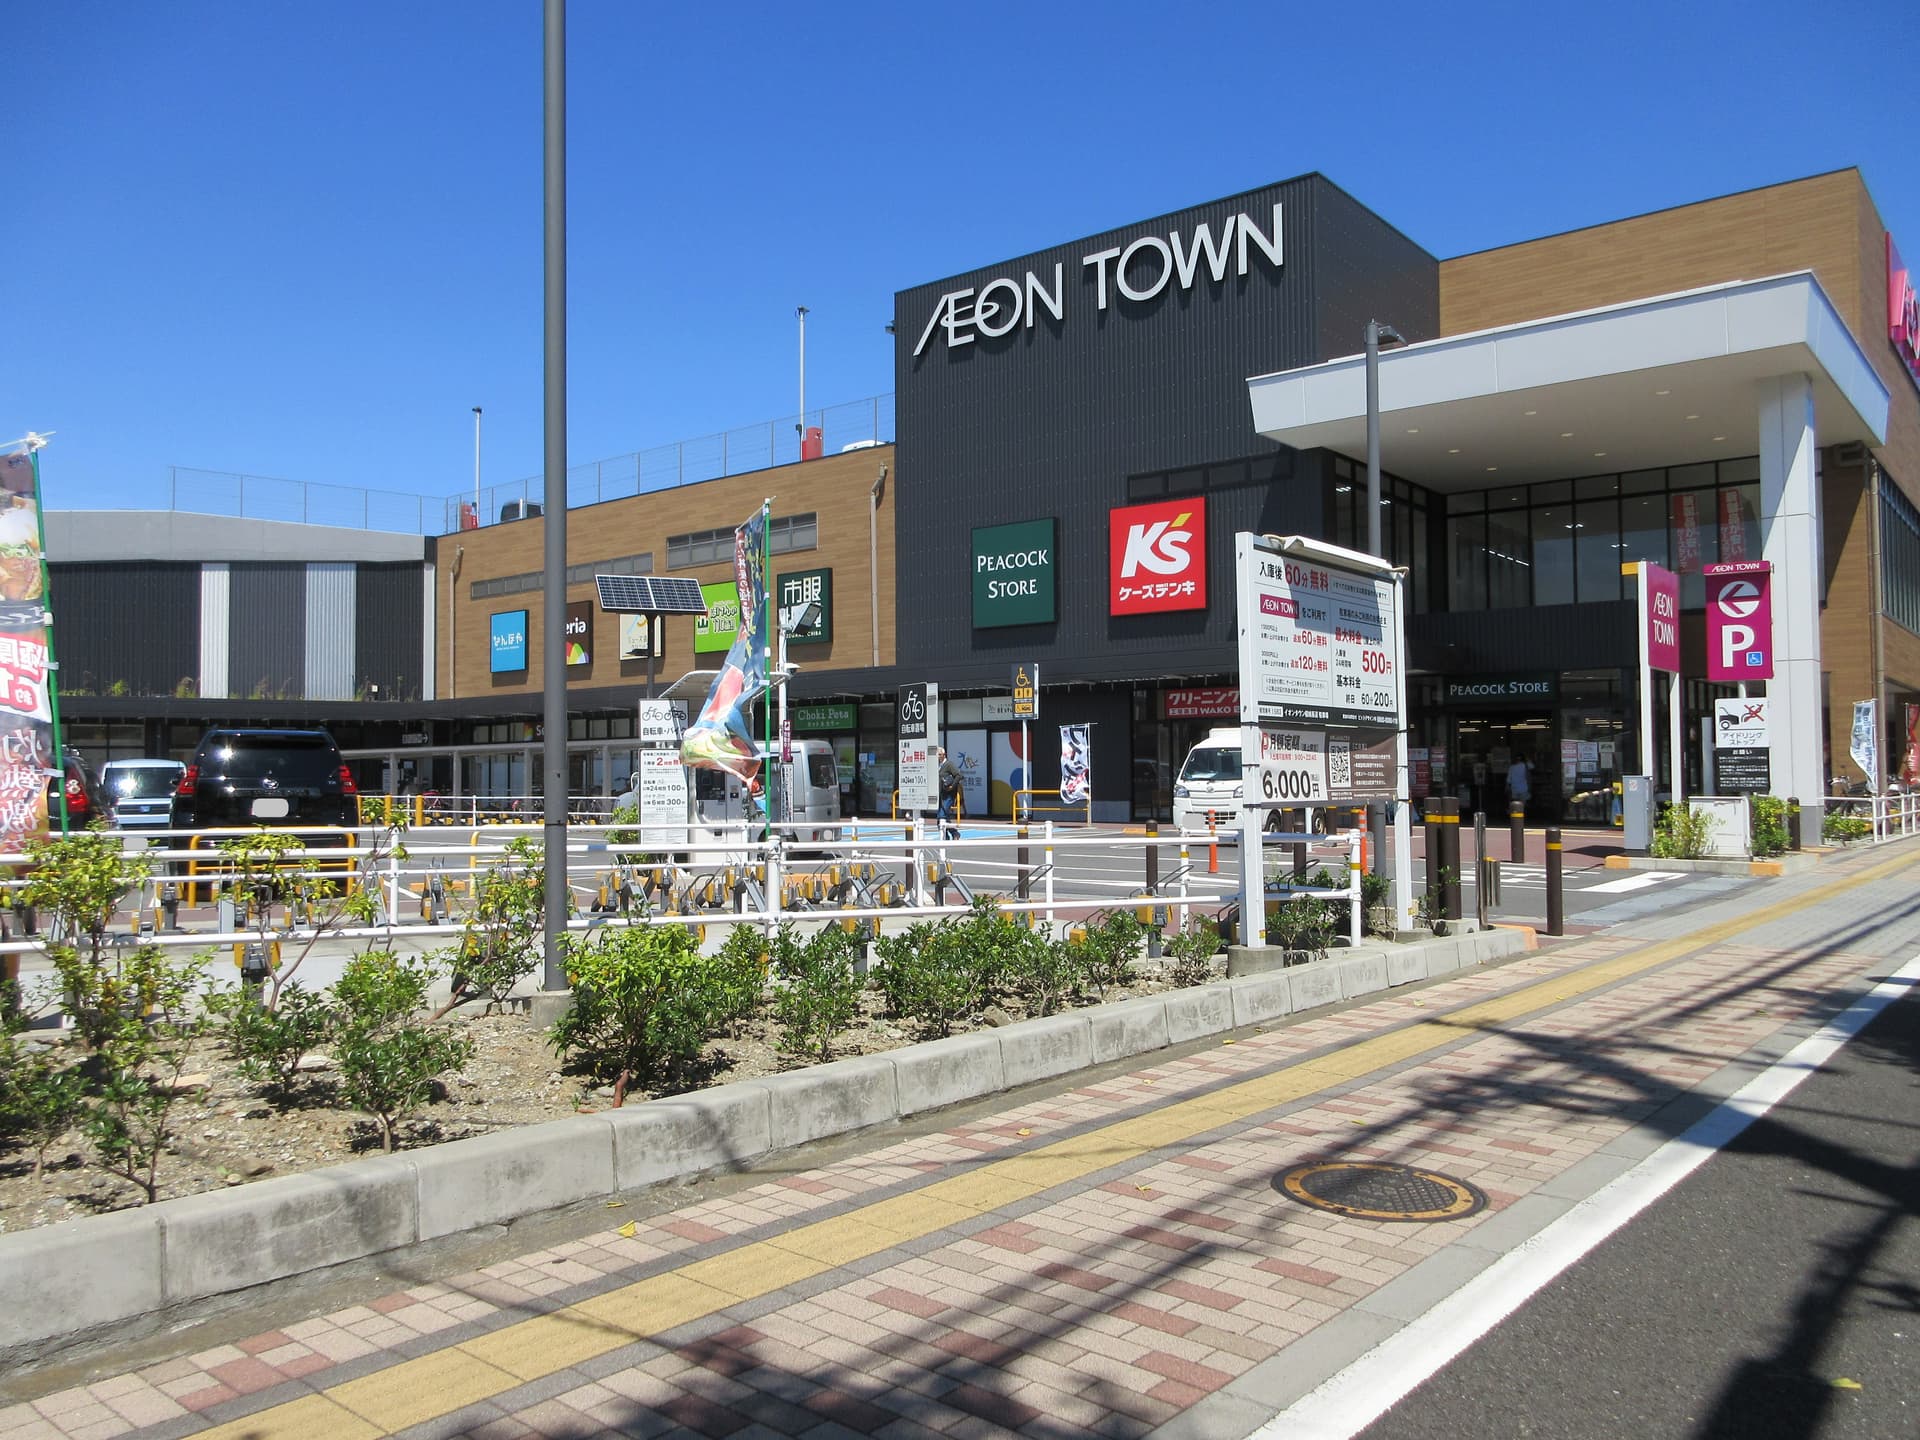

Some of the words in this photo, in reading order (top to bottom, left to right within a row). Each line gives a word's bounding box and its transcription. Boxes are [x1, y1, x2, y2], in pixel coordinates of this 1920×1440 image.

[1082, 202, 1284, 311] TOWN
[977, 550, 1049, 573] PEACOCK
[1736, 562, 1761, 571] TOWN
[988, 578, 1038, 599] STORE
[1119, 580, 1196, 602] ケーズデンキ
[1281, 602, 1298, 616] TOWN
[566, 617, 587, 635] eria
[1652, 619, 1675, 647] TOWN
[1721, 624, 1755, 668] P
[1362, 649, 1392, 675] 500円
[1336, 675, 1361, 689] 基本料金
[1200, 706, 1232, 714] WAKO
[1721, 732, 1763, 740] アイドリング
[1729, 738, 1756, 746] ストップ
[1262, 769, 1320, 800] 6,000円
